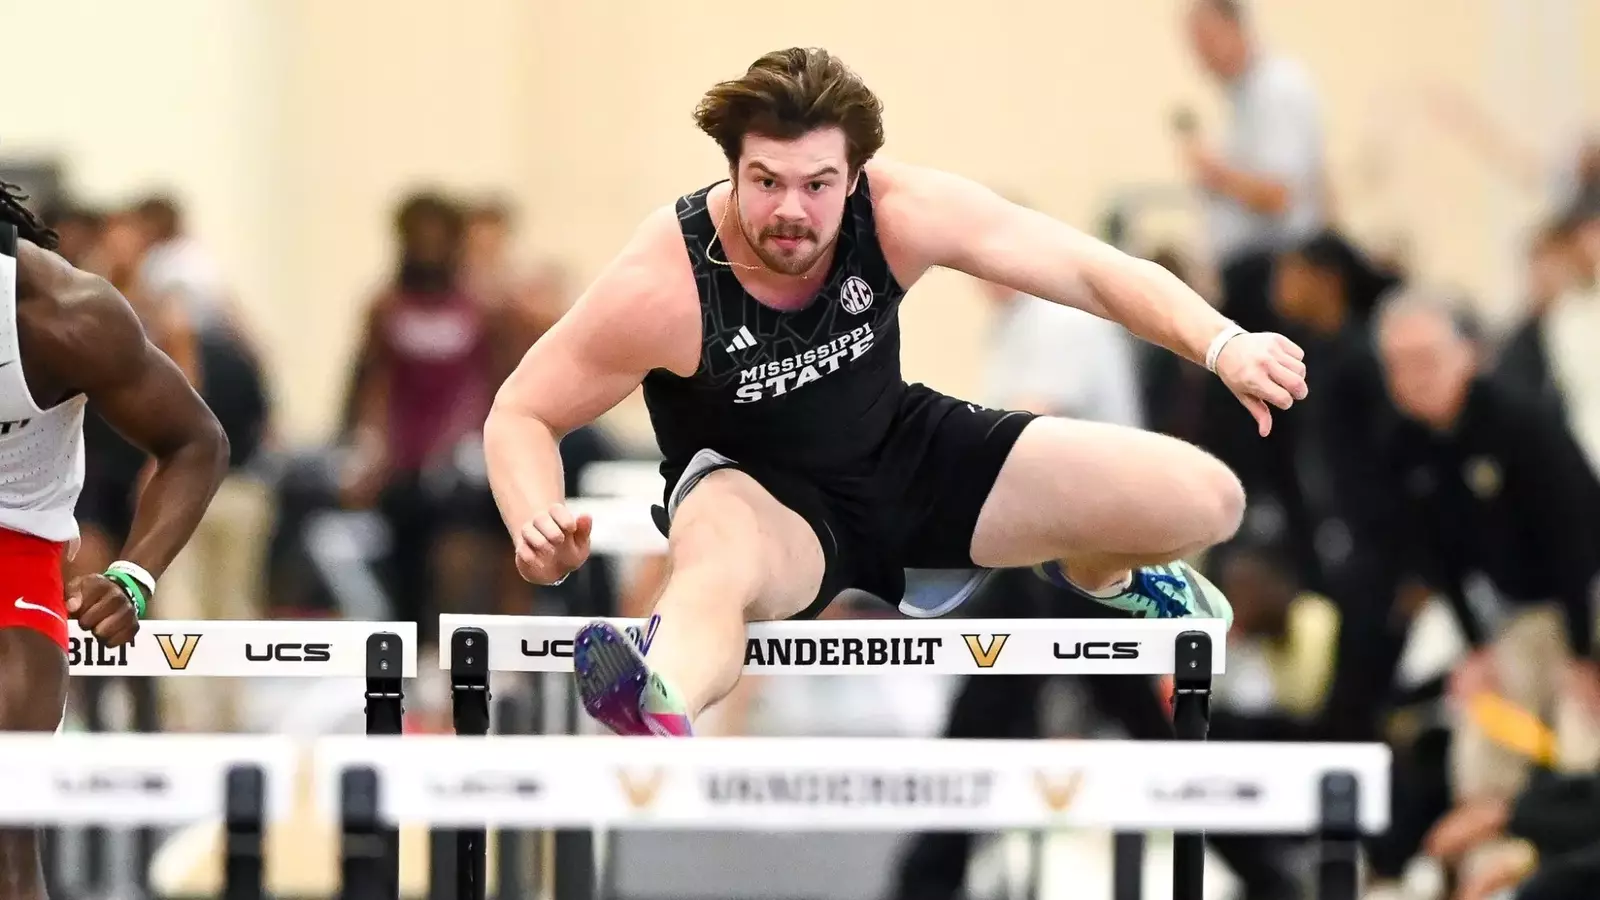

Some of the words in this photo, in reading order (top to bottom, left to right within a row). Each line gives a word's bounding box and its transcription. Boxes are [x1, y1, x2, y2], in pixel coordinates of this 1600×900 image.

[841, 278, 871, 313] SEC
[733, 332, 875, 404] STATE
[739, 322, 873, 385] MISSISSIPPI
[68, 637, 135, 666] BILT
[245, 643, 332, 662] UCS
[521, 639, 575, 658] UC
[745, 637, 943, 667] ANDERBILT
[1053, 641, 1141, 660] UCS
